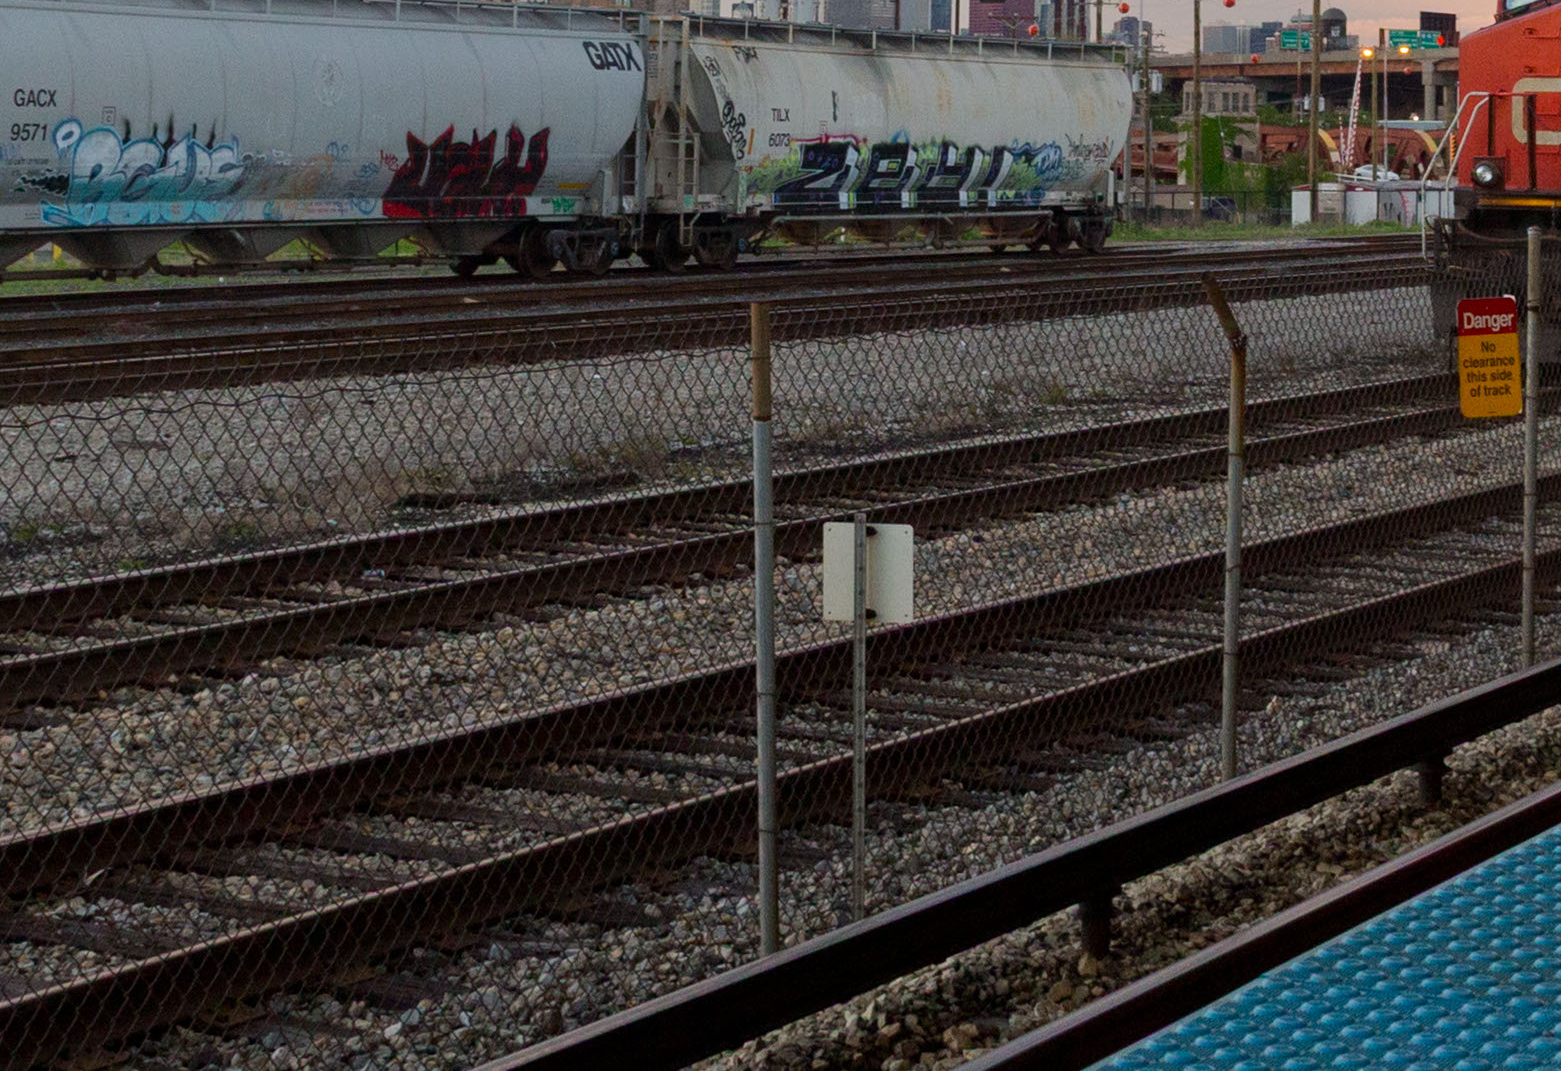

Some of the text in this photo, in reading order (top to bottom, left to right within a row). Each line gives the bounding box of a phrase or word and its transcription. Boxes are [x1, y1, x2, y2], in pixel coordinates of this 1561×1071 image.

[582, 41, 642, 72] GATX
[13, 88, 57, 107] GACX
[771, 108, 791, 122] TILX
[10, 123, 48, 141] 9571
[1463, 312, 1514, 332] Danger
[1481, 341, 1496, 353] No
[1463, 356, 1515, 369] clearance
[1467, 369, 1513, 383] this side
[1470, 383, 1512, 397] of track
